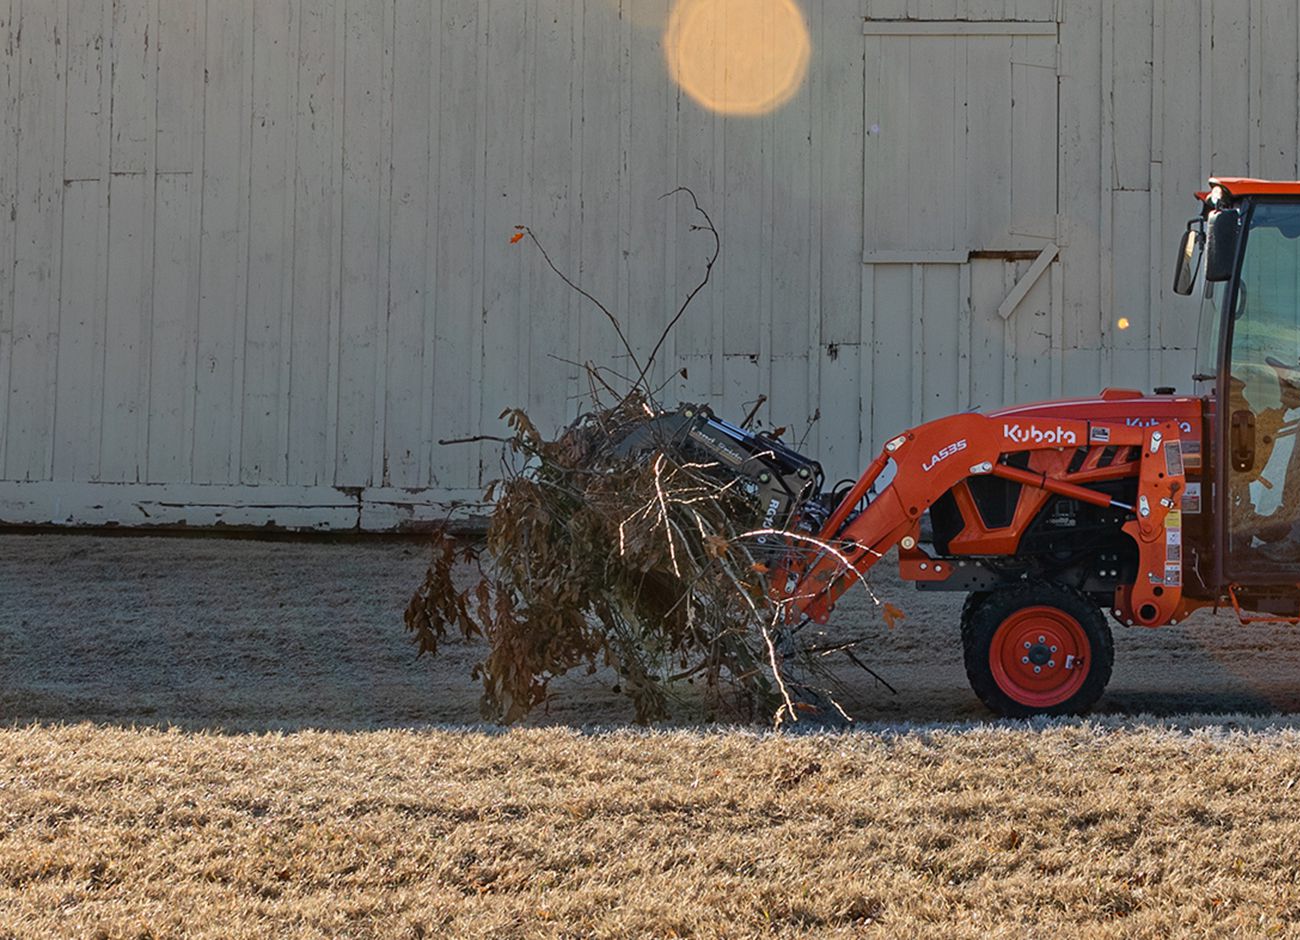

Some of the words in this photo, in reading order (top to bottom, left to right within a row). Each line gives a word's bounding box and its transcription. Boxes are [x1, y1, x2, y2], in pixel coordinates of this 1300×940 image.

[1003, 424, 1076, 443] Kubota
[922, 439, 967, 472] LA535
[757, 499, 780, 544] RG150
